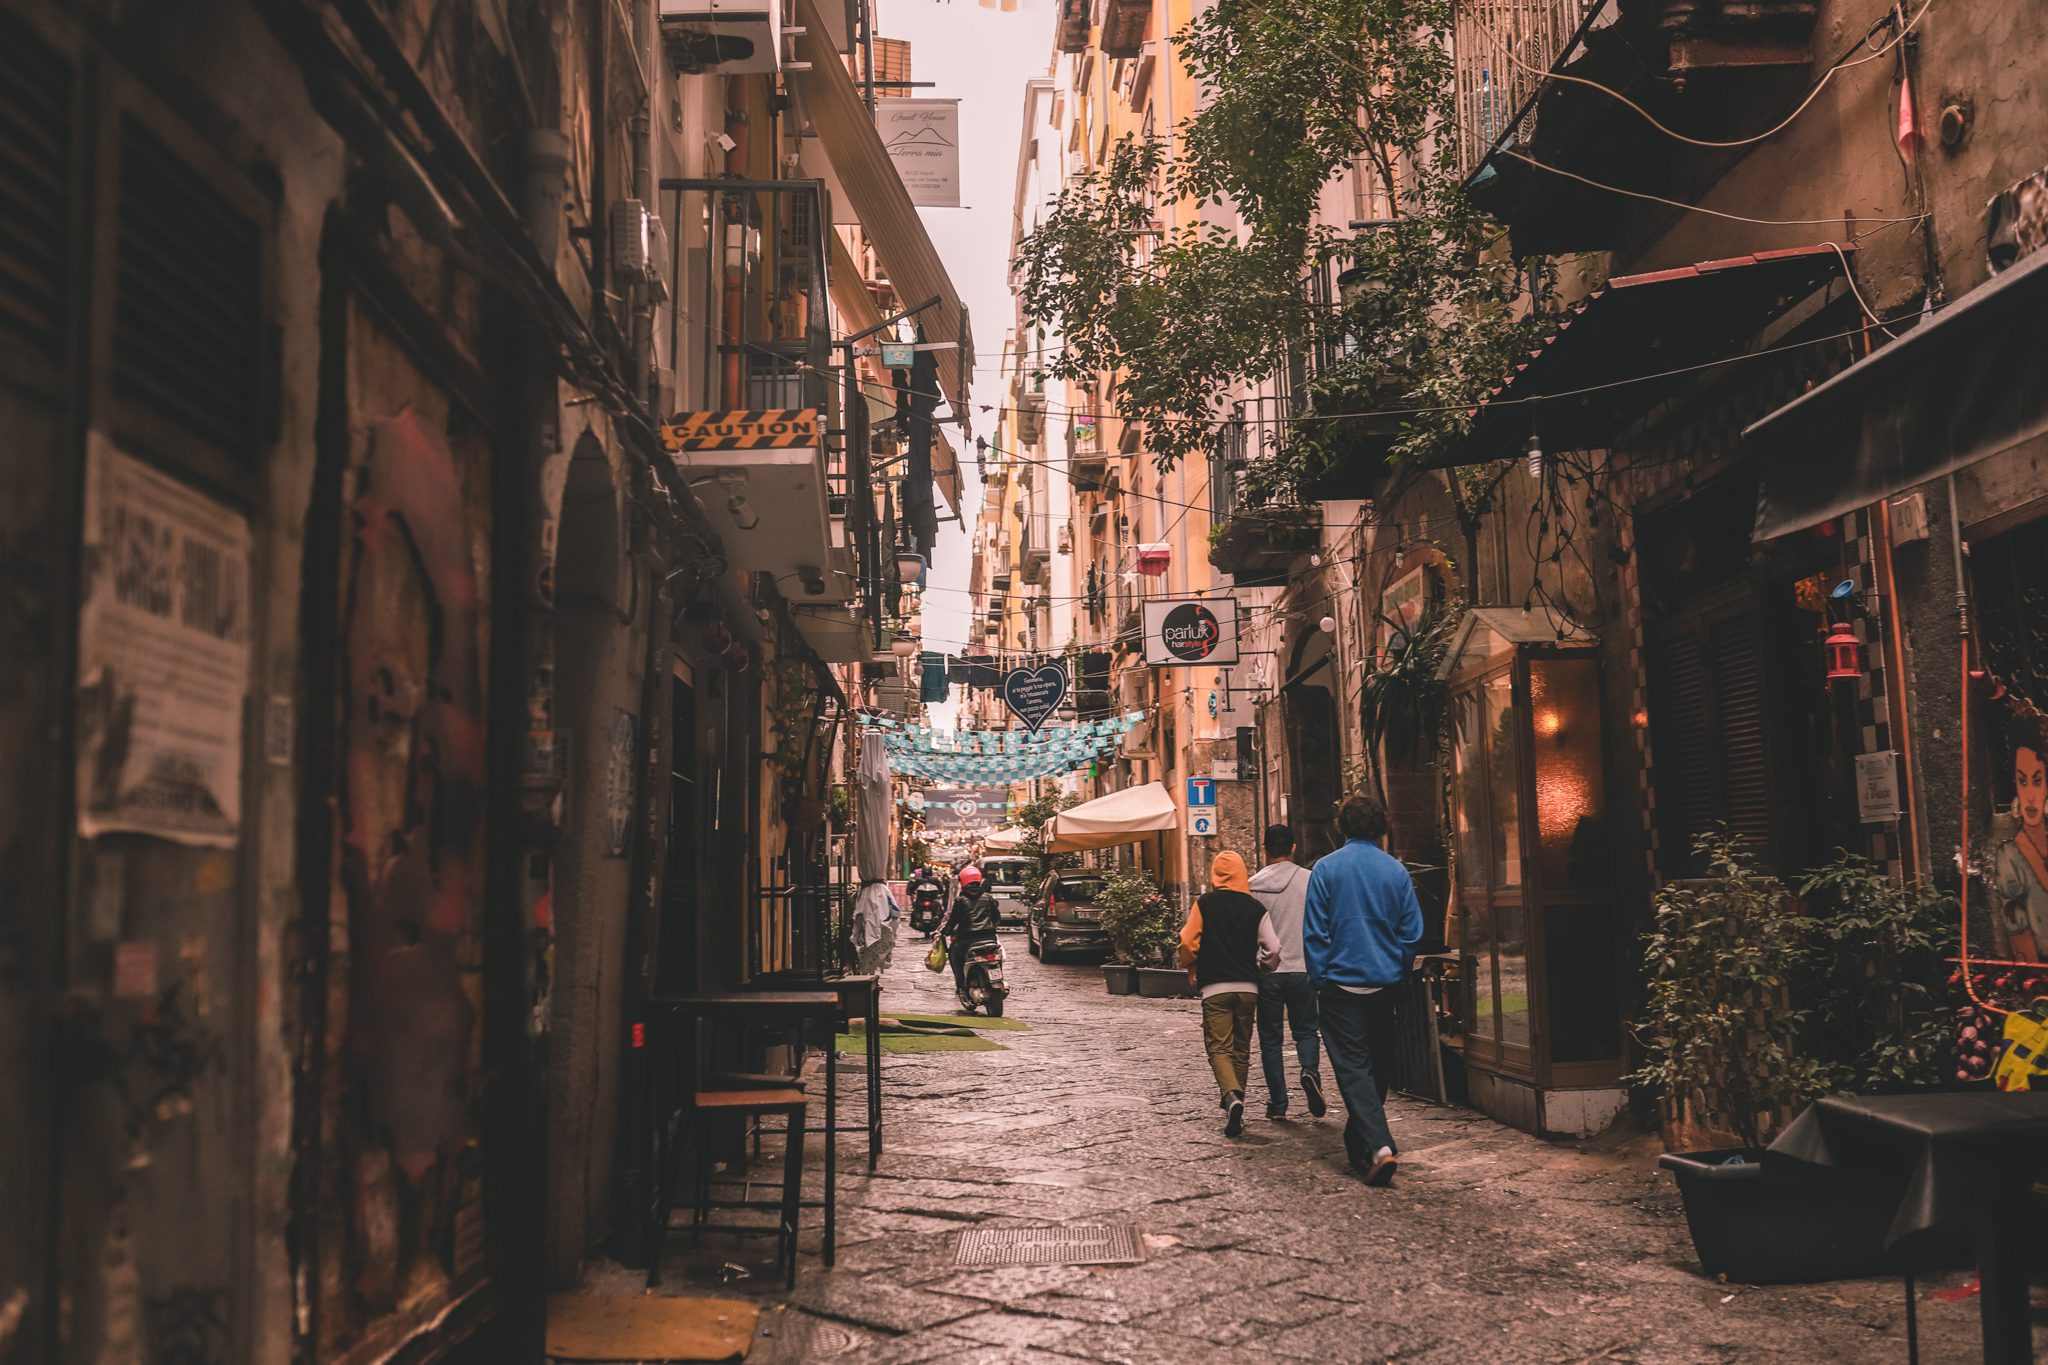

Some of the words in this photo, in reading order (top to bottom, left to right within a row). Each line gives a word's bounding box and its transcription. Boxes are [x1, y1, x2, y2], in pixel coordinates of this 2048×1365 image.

[891, 112, 917, 122] Guest
[920, 112, 946, 122] House
[889, 145, 922, 157] Terra
[925, 149, 943, 157] mia
[672, 422, 811, 438] CAUTION
[1897, 505, 1912, 528] 40
[1165, 624, 1209, 643] parlux
